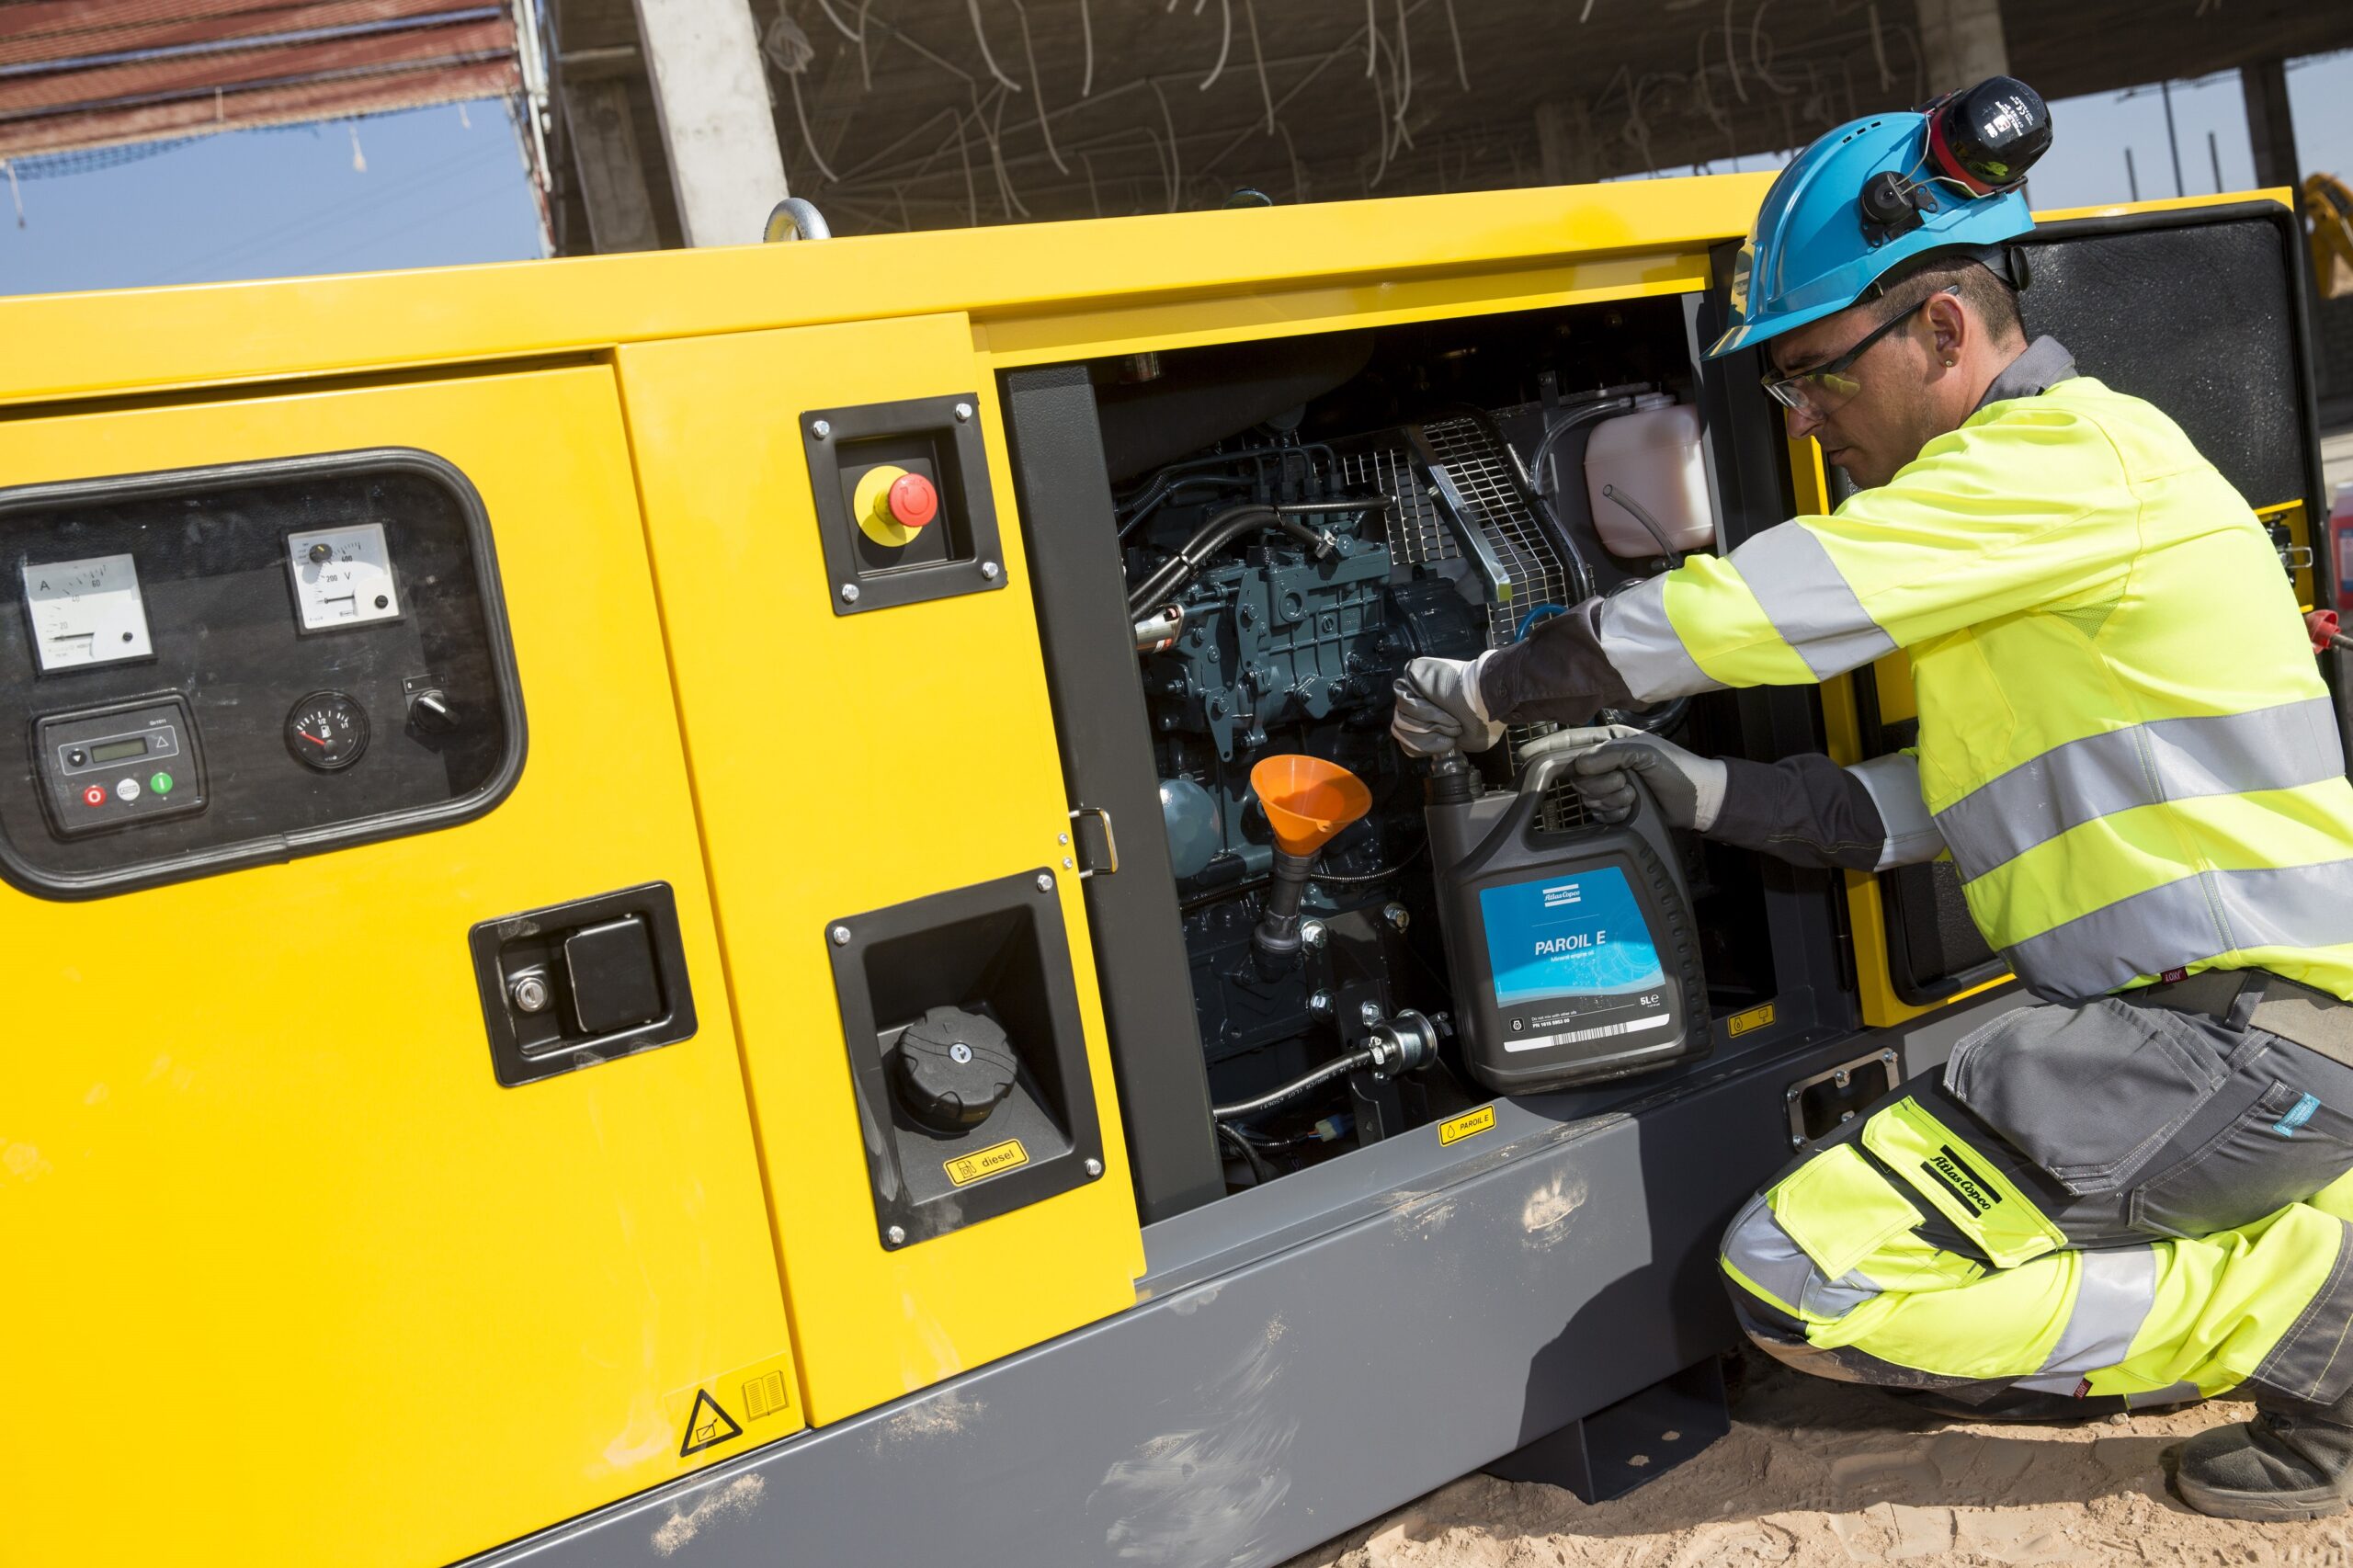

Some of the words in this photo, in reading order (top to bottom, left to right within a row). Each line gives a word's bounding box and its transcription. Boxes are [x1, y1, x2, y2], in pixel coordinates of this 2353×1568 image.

[1995, 100, 2022, 137] PELTOR
[40, 580, 51, 591] A
[325, 574, 338, 583] 200
[344, 572, 351, 580] V
[59, 621, 68, 631] 20
[1544, 893, 1563, 902] Atlas
[1562, 890, 1580, 899] Copco
[1535, 934, 1592, 956] PAROIL
[1596, 930, 1606, 945] E
[1460, 1117, 1483, 1131] PAROIL
[1484, 1114, 1490, 1122] E
[982, 1149, 1015, 1167] diesel
[1929, 1156, 1963, 1183] Atlas
[1961, 1180, 1992, 1210] Copco
